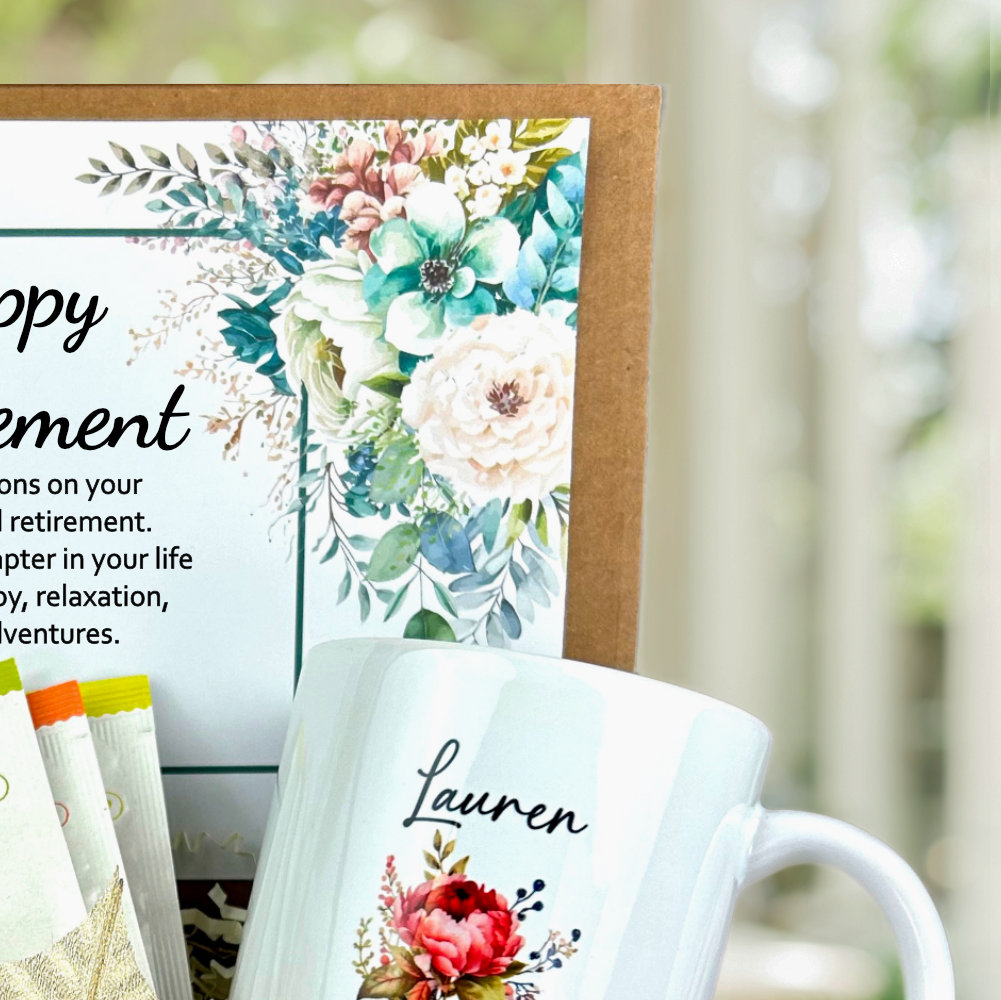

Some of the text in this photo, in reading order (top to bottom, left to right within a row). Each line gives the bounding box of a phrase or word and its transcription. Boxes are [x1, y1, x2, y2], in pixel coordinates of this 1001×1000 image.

[48, 478, 78, 495] on
[85, 478, 143, 501] your
[10, 509, 152, 533] retirement.
[63, 547, 84, 570] in
[91, 552, 149, 576] your
[156, 545, 193, 570] life
[36, 583, 169, 613] relaxation,
[403, 739, 588, 834] Lauren
